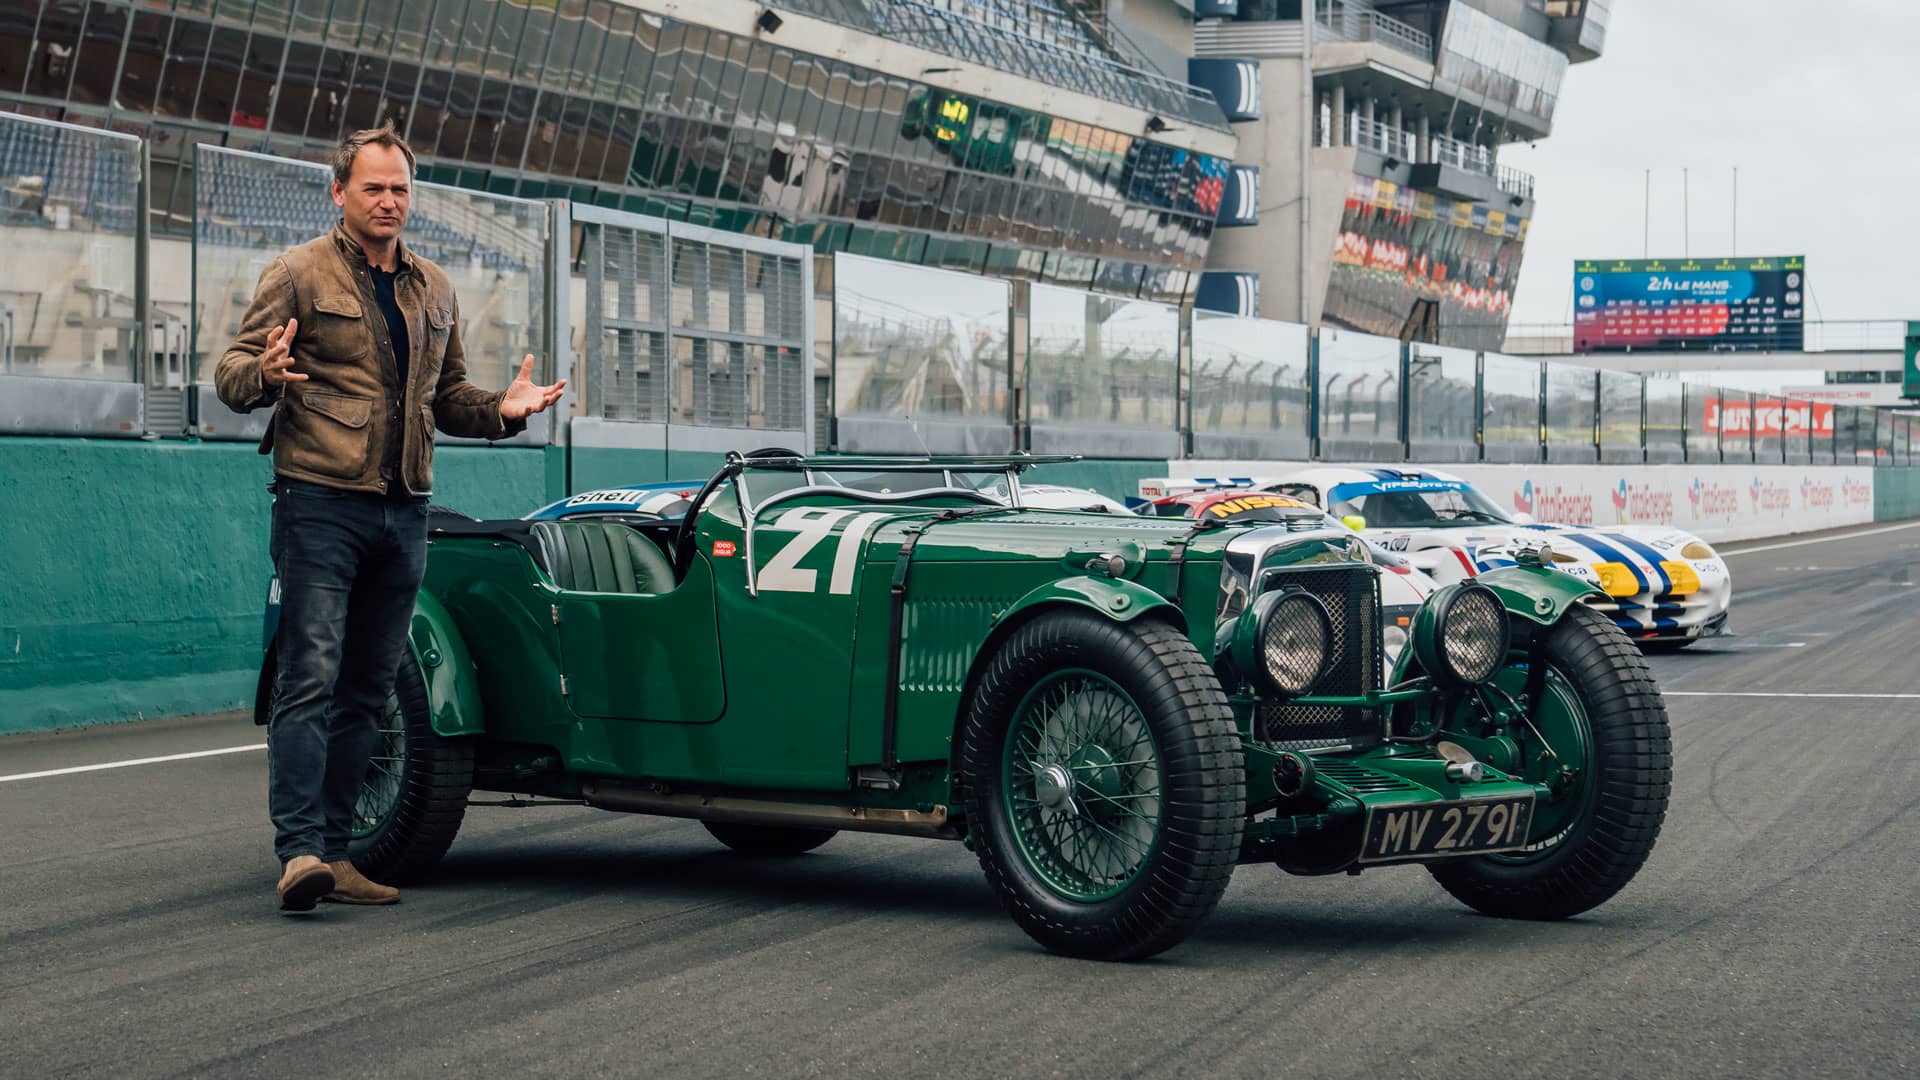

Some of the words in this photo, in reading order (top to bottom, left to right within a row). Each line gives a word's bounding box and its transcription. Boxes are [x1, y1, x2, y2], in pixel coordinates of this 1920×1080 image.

[1692, 280, 1729, 290] MANS
[572, 490, 643, 505] Shell
[1142, 487, 1162, 497] TOTAL
[757, 506, 895, 595] 21
[1379, 809, 1433, 854] MV
[1434, 803, 1520, 849] 2791
